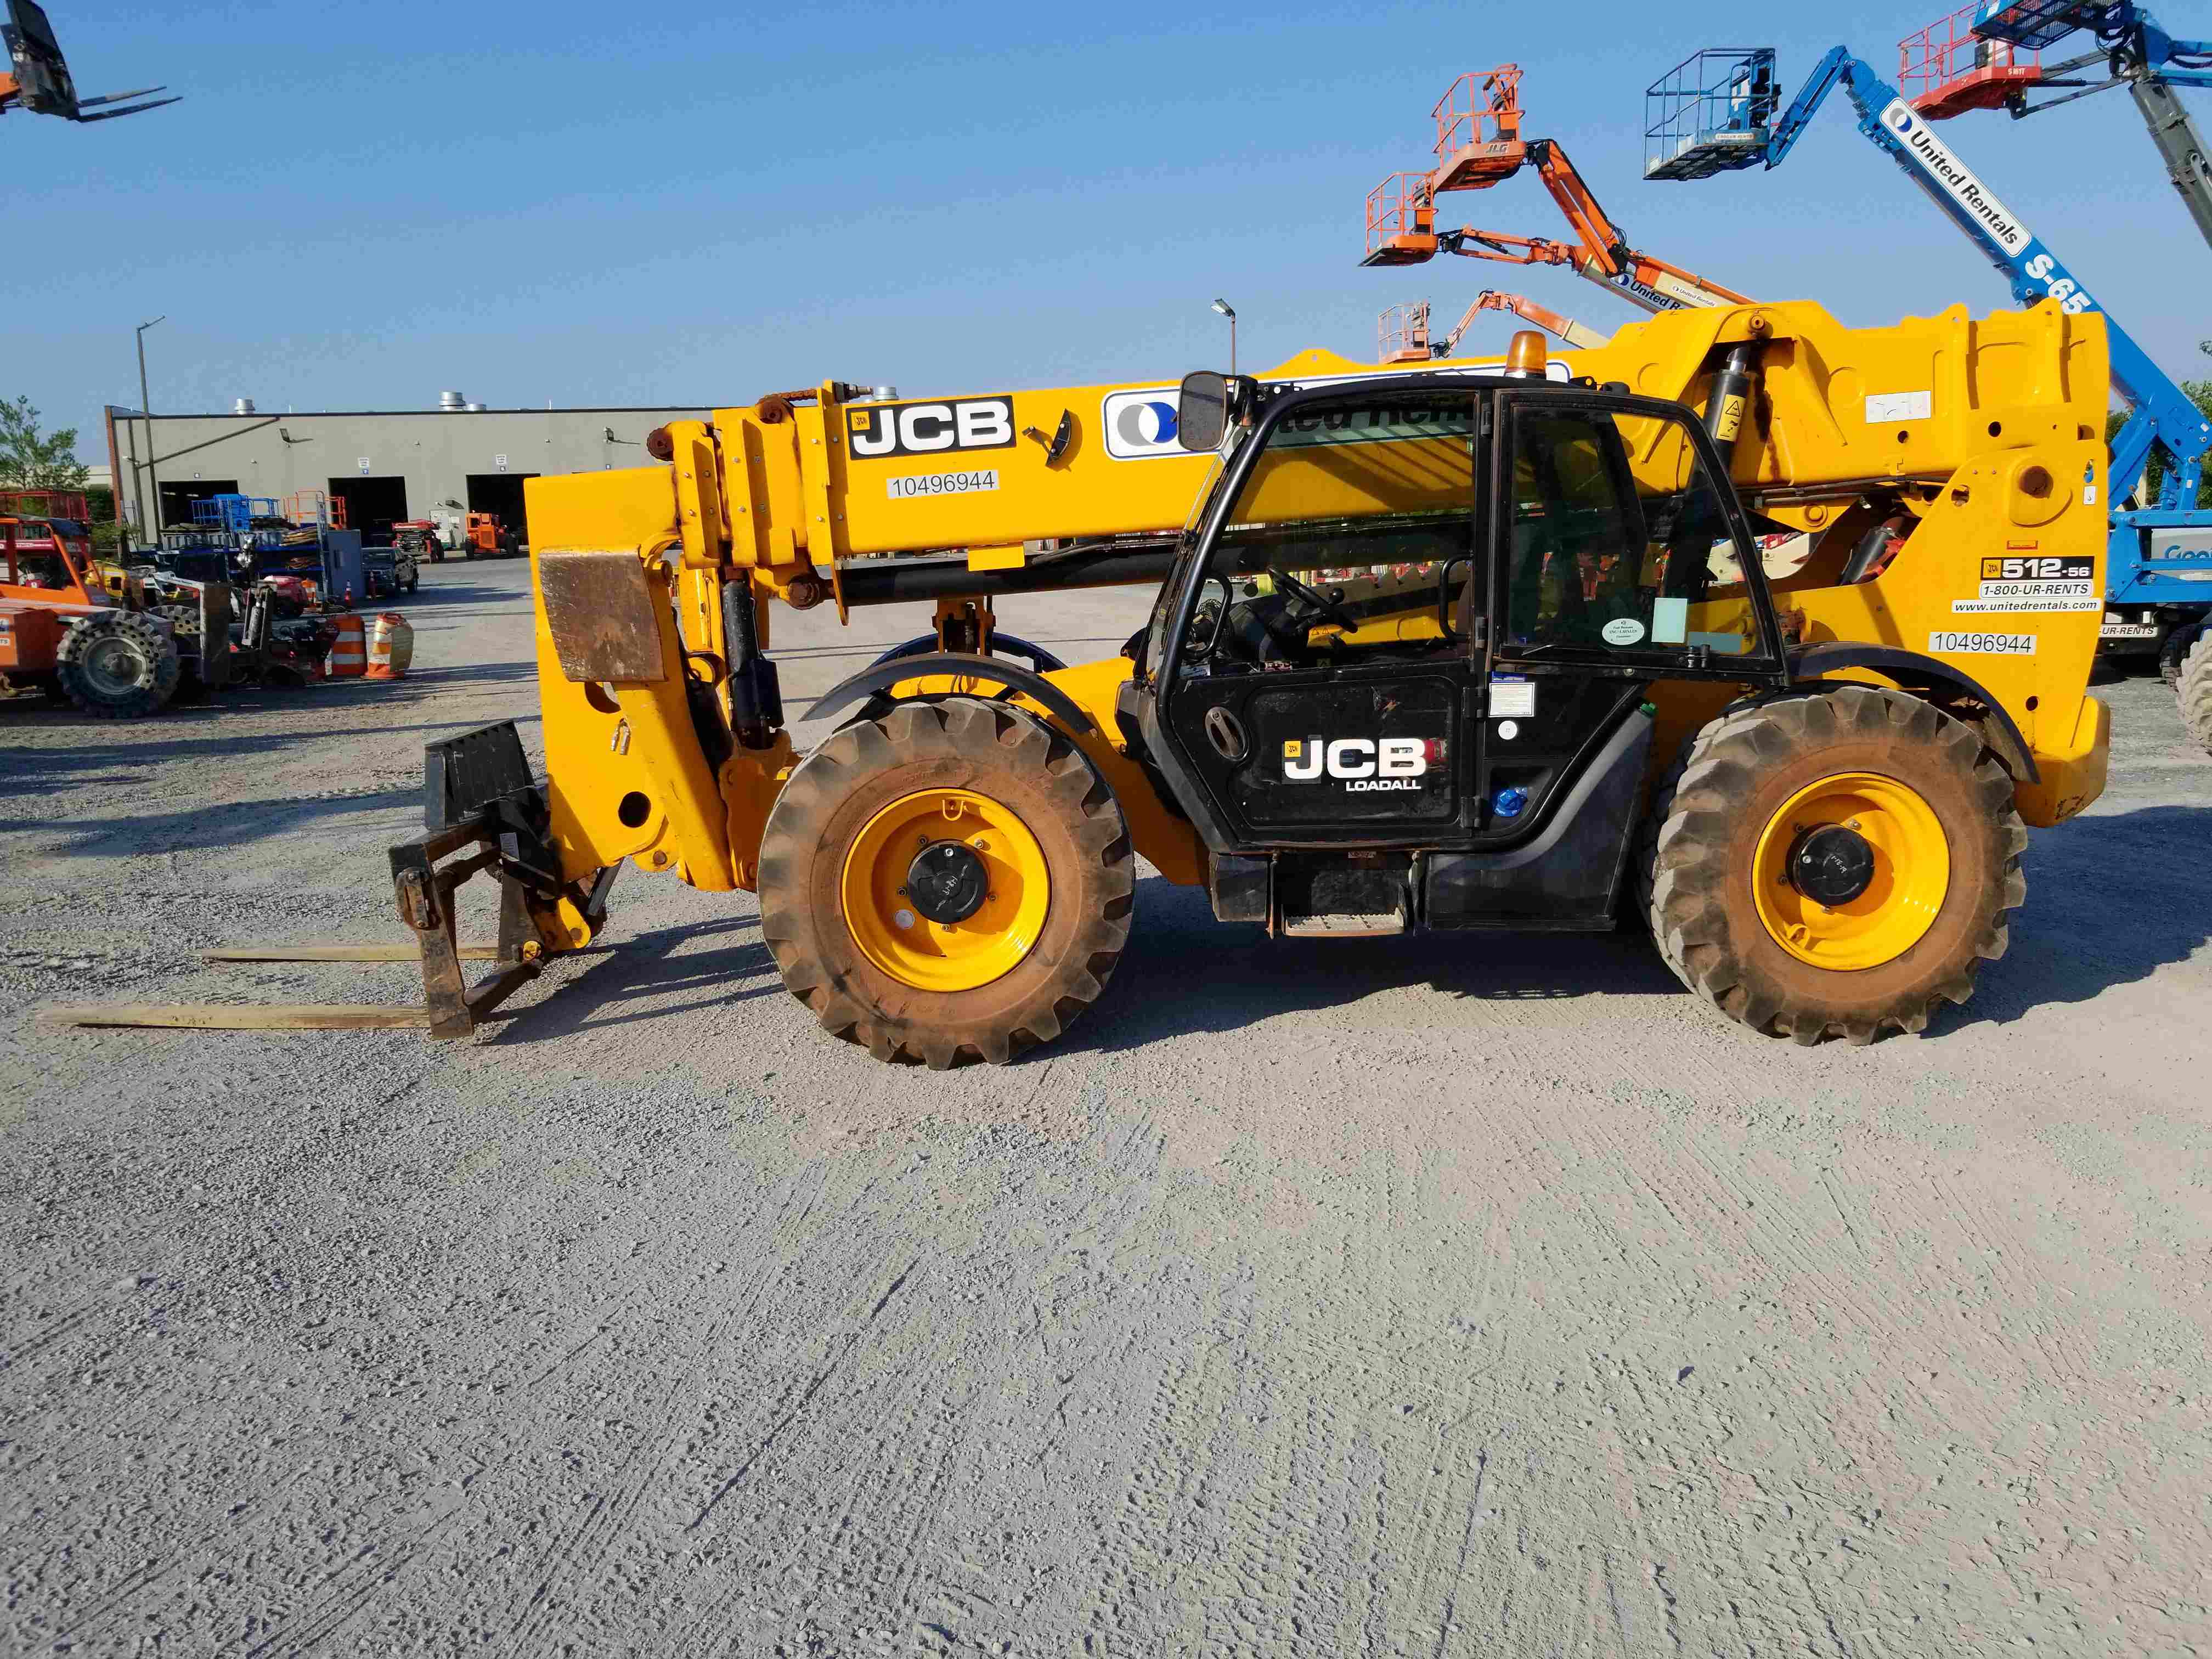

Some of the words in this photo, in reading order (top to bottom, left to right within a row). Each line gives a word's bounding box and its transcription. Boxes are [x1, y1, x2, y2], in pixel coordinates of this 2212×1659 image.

[1910, 131, 1966, 187] United
[1960, 184, 2018, 244] Rentals
[1630, 281, 1669, 307] United
[1679, 288, 1696, 300] United
[2025, 254, 2091, 314] S-65
[853, 401, 1012, 455] JCB
[893, 471, 995, 496] 10496944
[2002, 558, 2090, 578] 512-56
[1984, 584, 2089, 595] 1-800-UR-RENTS
[1955, 601, 2097, 611] www.unitedrentals.com
[1935, 633, 2032, 653] 10496944
[1285, 738, 1426, 779] JCB
[1346, 780, 1421, 791] LOADALL
